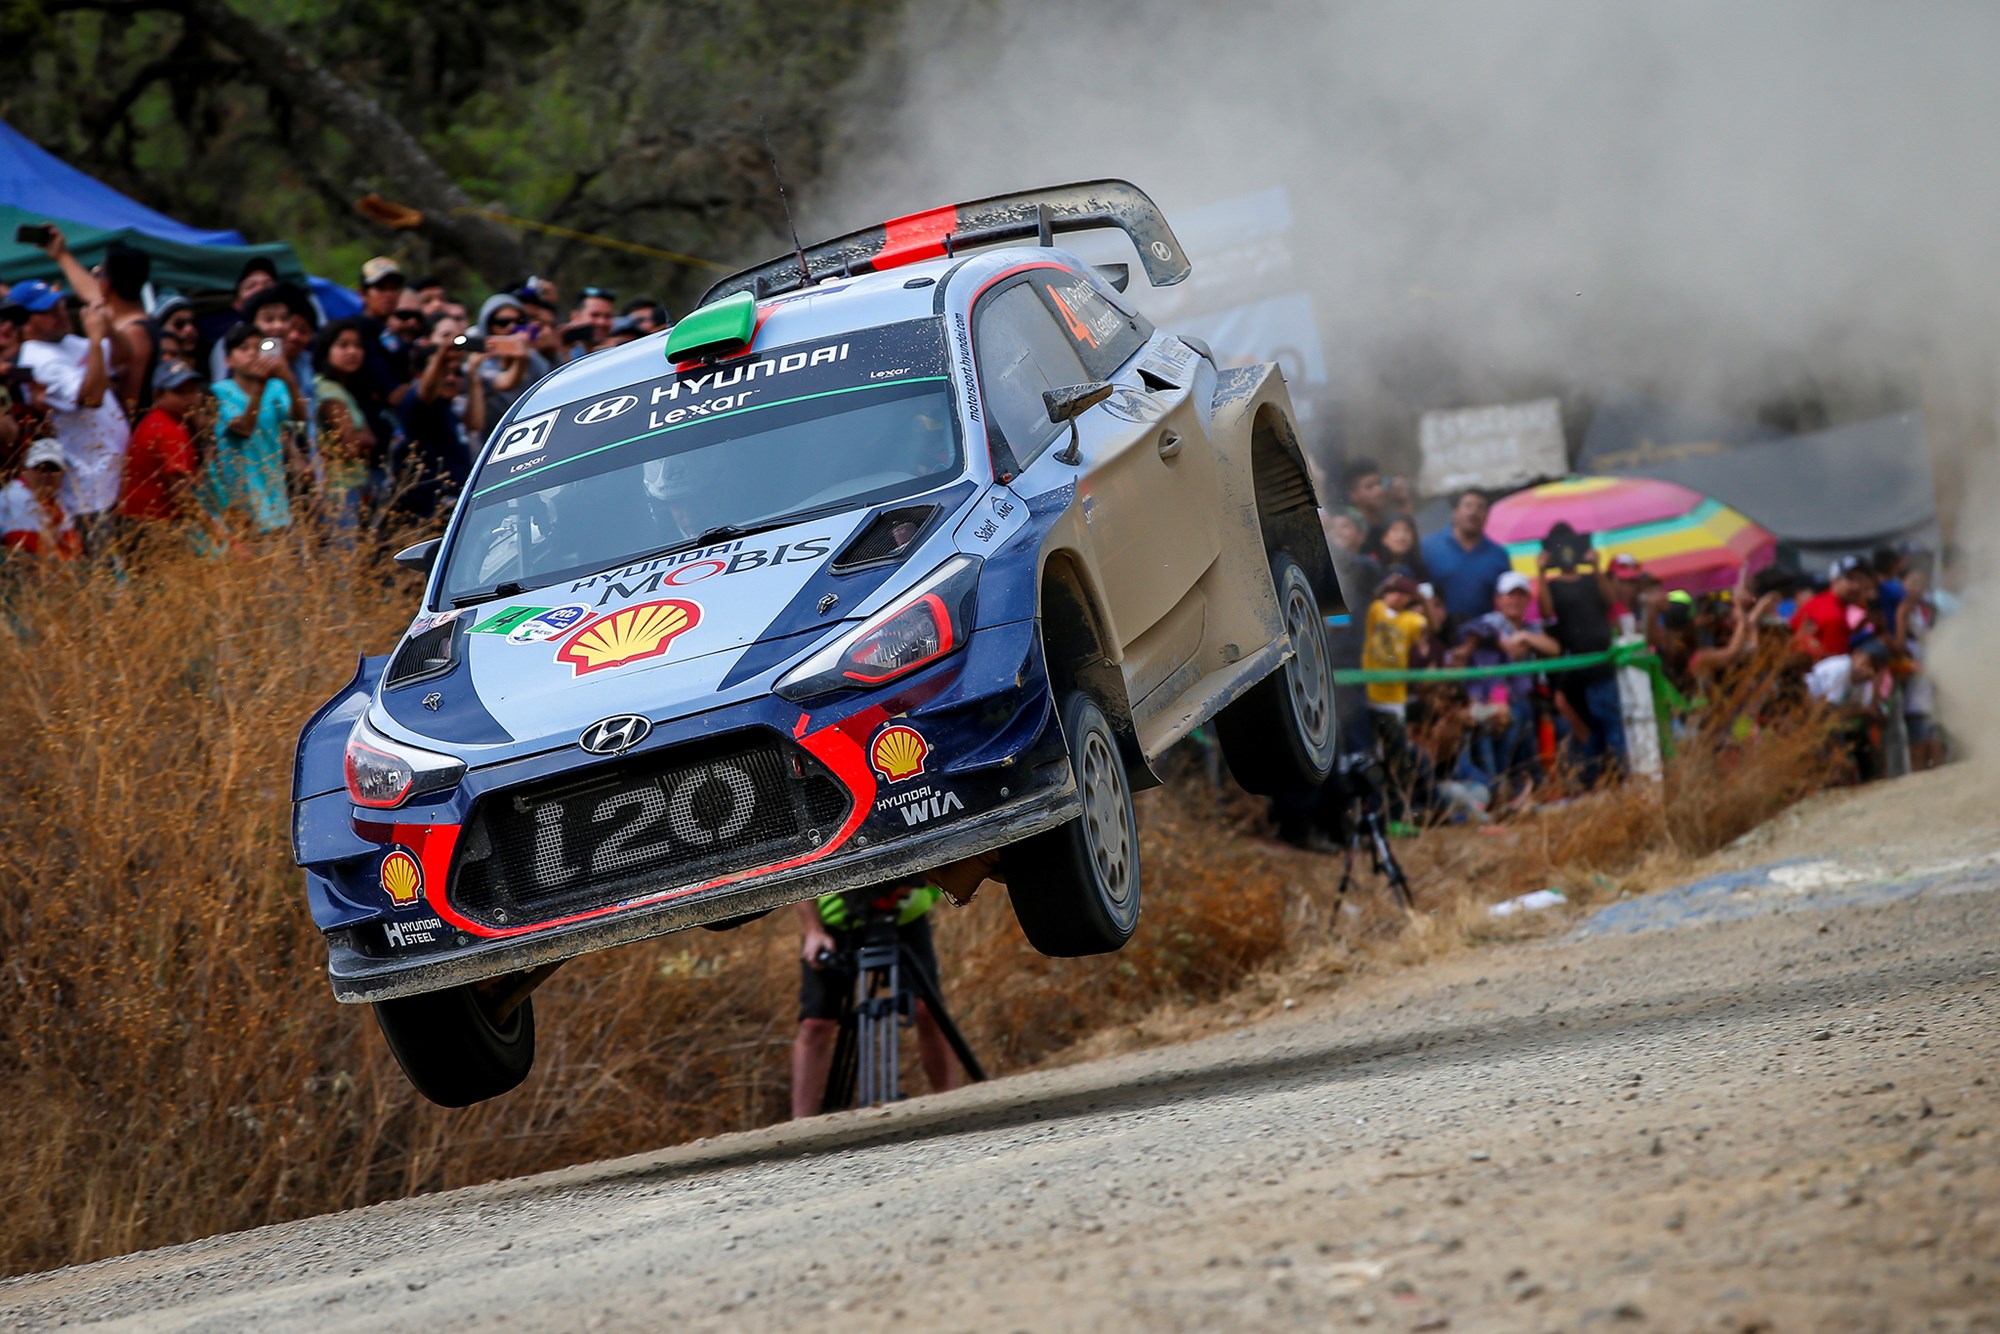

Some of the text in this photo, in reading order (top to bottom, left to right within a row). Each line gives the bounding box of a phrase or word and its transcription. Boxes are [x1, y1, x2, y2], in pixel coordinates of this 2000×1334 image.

[1046, 283, 1098, 350] 4
[650, 342, 850, 405] HYUNDAI
[870, 367, 911, 379] Lexar
[954, 312, 980, 423] motorsport.hyundai.com
[497, 419, 549, 455] P1
[510, 454, 547, 473] Lexar
[570, 540, 744, 594] HYUNDAI
[595, 536, 832, 607] MOBIS
[876, 785, 932, 811] HYUNDAI
[400, 918, 442, 933] HYUNDAI
[405, 932, 436, 945] STEEL
